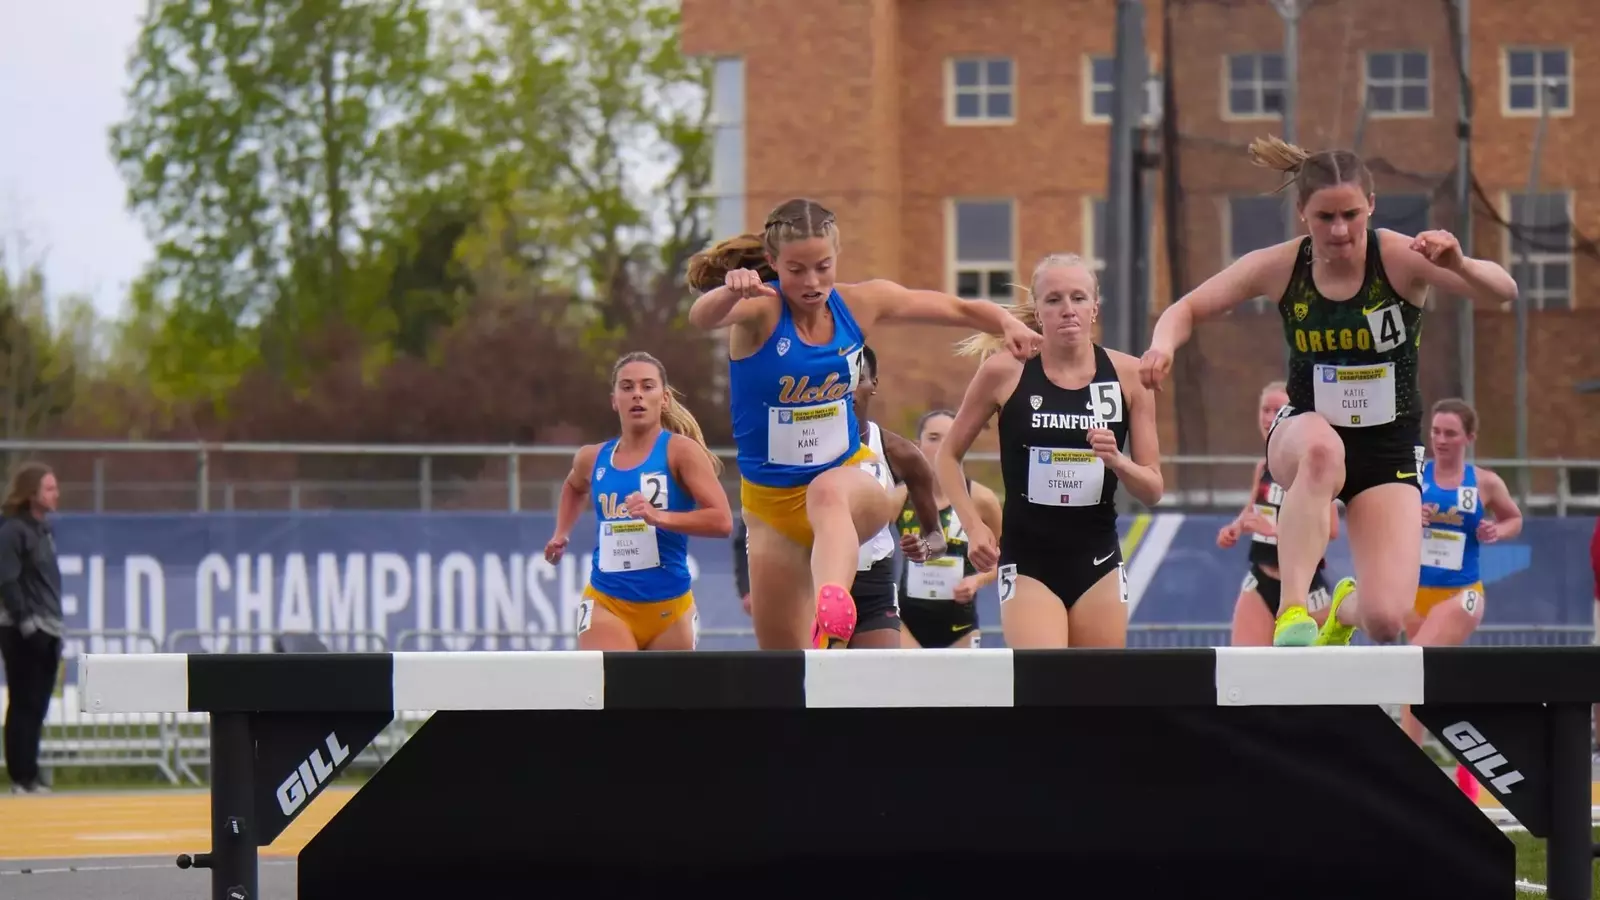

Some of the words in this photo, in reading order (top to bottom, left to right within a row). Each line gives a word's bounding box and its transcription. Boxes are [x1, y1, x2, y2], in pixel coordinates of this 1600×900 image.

[1381, 309, 1401, 345] 4
[1295, 328, 1376, 353] OREGO
[779, 372, 848, 403] Ucla
[1344, 388, 1365, 397] KATIE
[1098, 384, 1117, 420] 5
[1342, 399, 1368, 409] CLUTE
[798, 438, 819, 448] KANE
[802, 428, 816, 436] MIA
[1048, 480, 1083, 489] STEWART
[1056, 470, 1076, 478] RILEY
[646, 478, 663, 508] 2
[1462, 489, 1474, 510] 8
[598, 493, 635, 519] Uc
[613, 548, 640, 557] BROWNE
[1001, 566, 1012, 602] 5
[57, 555, 166, 656] ELD
[197, 552, 698, 653] CHAMPIONSH
[1466, 591, 1477, 612] 8
[579, 603, 588, 633] 2
[1442, 721, 1525, 795] GILL
[276, 731, 350, 816] GILL
